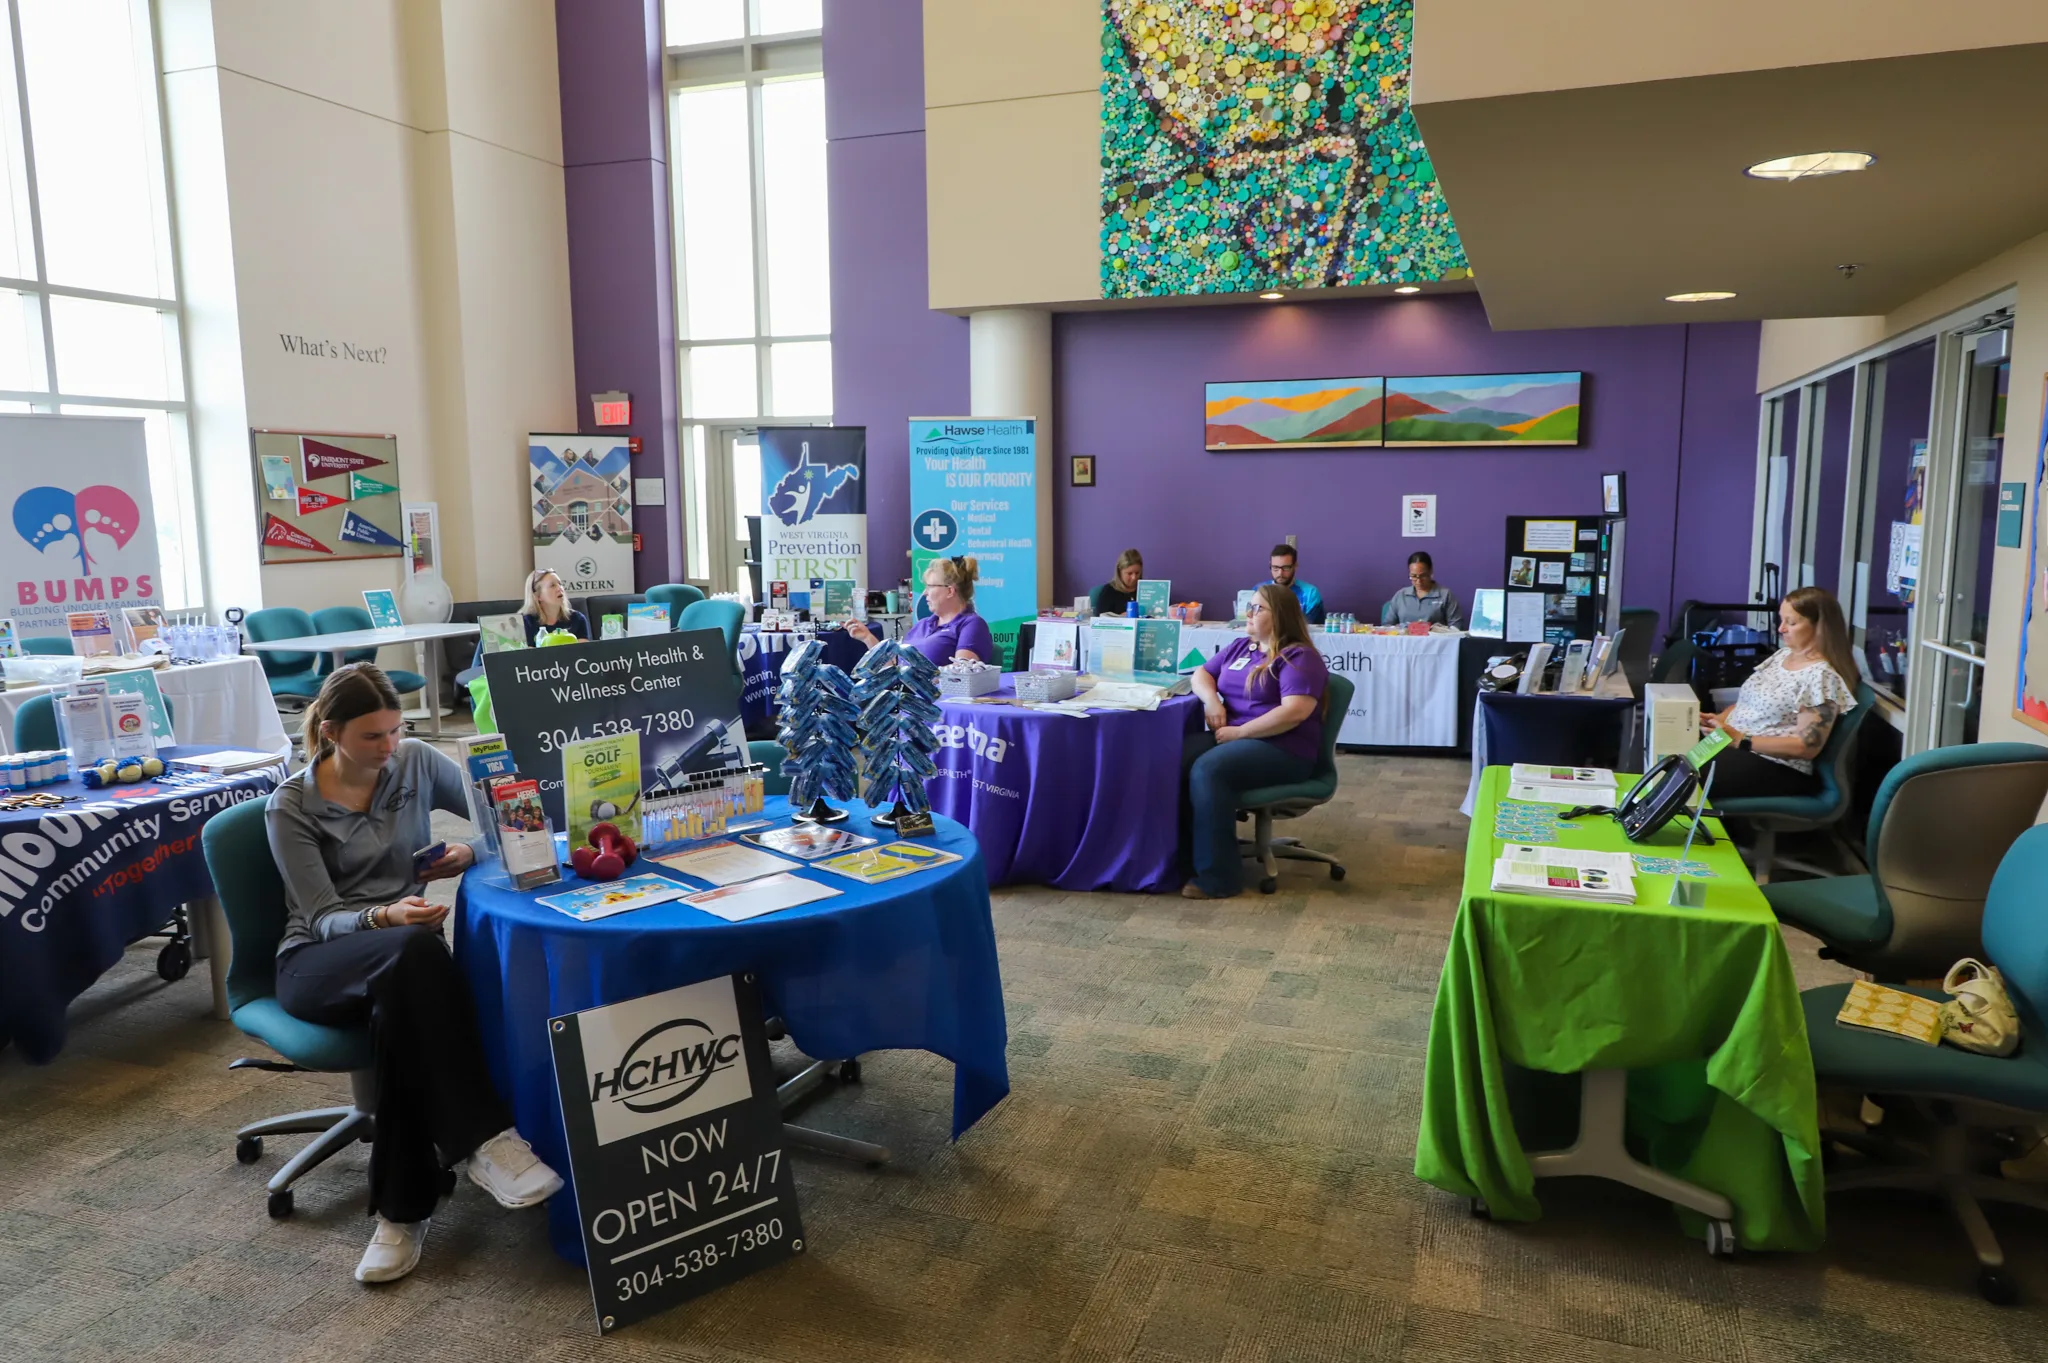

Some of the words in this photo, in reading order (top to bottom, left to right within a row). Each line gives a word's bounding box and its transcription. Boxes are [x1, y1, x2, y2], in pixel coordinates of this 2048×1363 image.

[276, 334, 338, 358] What's
[342, 342, 386, 364] Next?
[602, 403, 623, 424] EXIT
[944, 425, 984, 436] Hawse
[987, 425, 1023, 436] Health
[916, 446, 948, 456] Providing
[950, 446, 974, 456] Quality
[993, 446, 1011, 455] Since
[1014, 446, 1029, 455] 1981
[924, 457, 950, 470] Your
[952, 456, 986, 470] Health
[946, 473, 956, 487] IS
[958, 472, 981, 487] OUR
[984, 472, 1032, 487] PRIORITY
[951, 500, 968, 511] Our
[970, 500, 1010, 511] Services
[968, 514, 996, 522] Medical
[968, 526, 991, 535] Dental
[768, 540, 862, 555] Prevention
[774, 558, 856, 580] FIRST
[18, 575, 153, 606] BUMPS
[10, 604, 60, 616] BUILDING
[63, 602, 104, 613] UNIQUE
[993, 632, 1014, 643] BOUT
[515, 661, 570, 683] Hardy
[574, 655, 633, 675] County
[637, 647, 688, 668] Health
[692, 645, 704, 660] &
[1321, 651, 1372, 672] ealth
[551, 681, 626, 703] Wellness
[631, 675, 682, 693] Center
[538, 708, 694, 753] 304-538-7380
[473, 744, 500, 753] MyPlate
[584, 748, 621, 767] GOLF
[486, 761, 504, 773] YOGA
[585, 763, 622, 774] TOURNAMENT
[986, 784, 1020, 798] VIRGINIA
[21, 813, 161, 932] Community
[168, 786, 267, 822] Services
[592, 1034, 741, 1103] HCHWC
[642, 1118, 728, 1174] NOW
[592, 1181, 698, 1245] OPEN
[708, 1150, 782, 1205] 24/7
[616, 1218, 783, 1301] 304-538-7380
